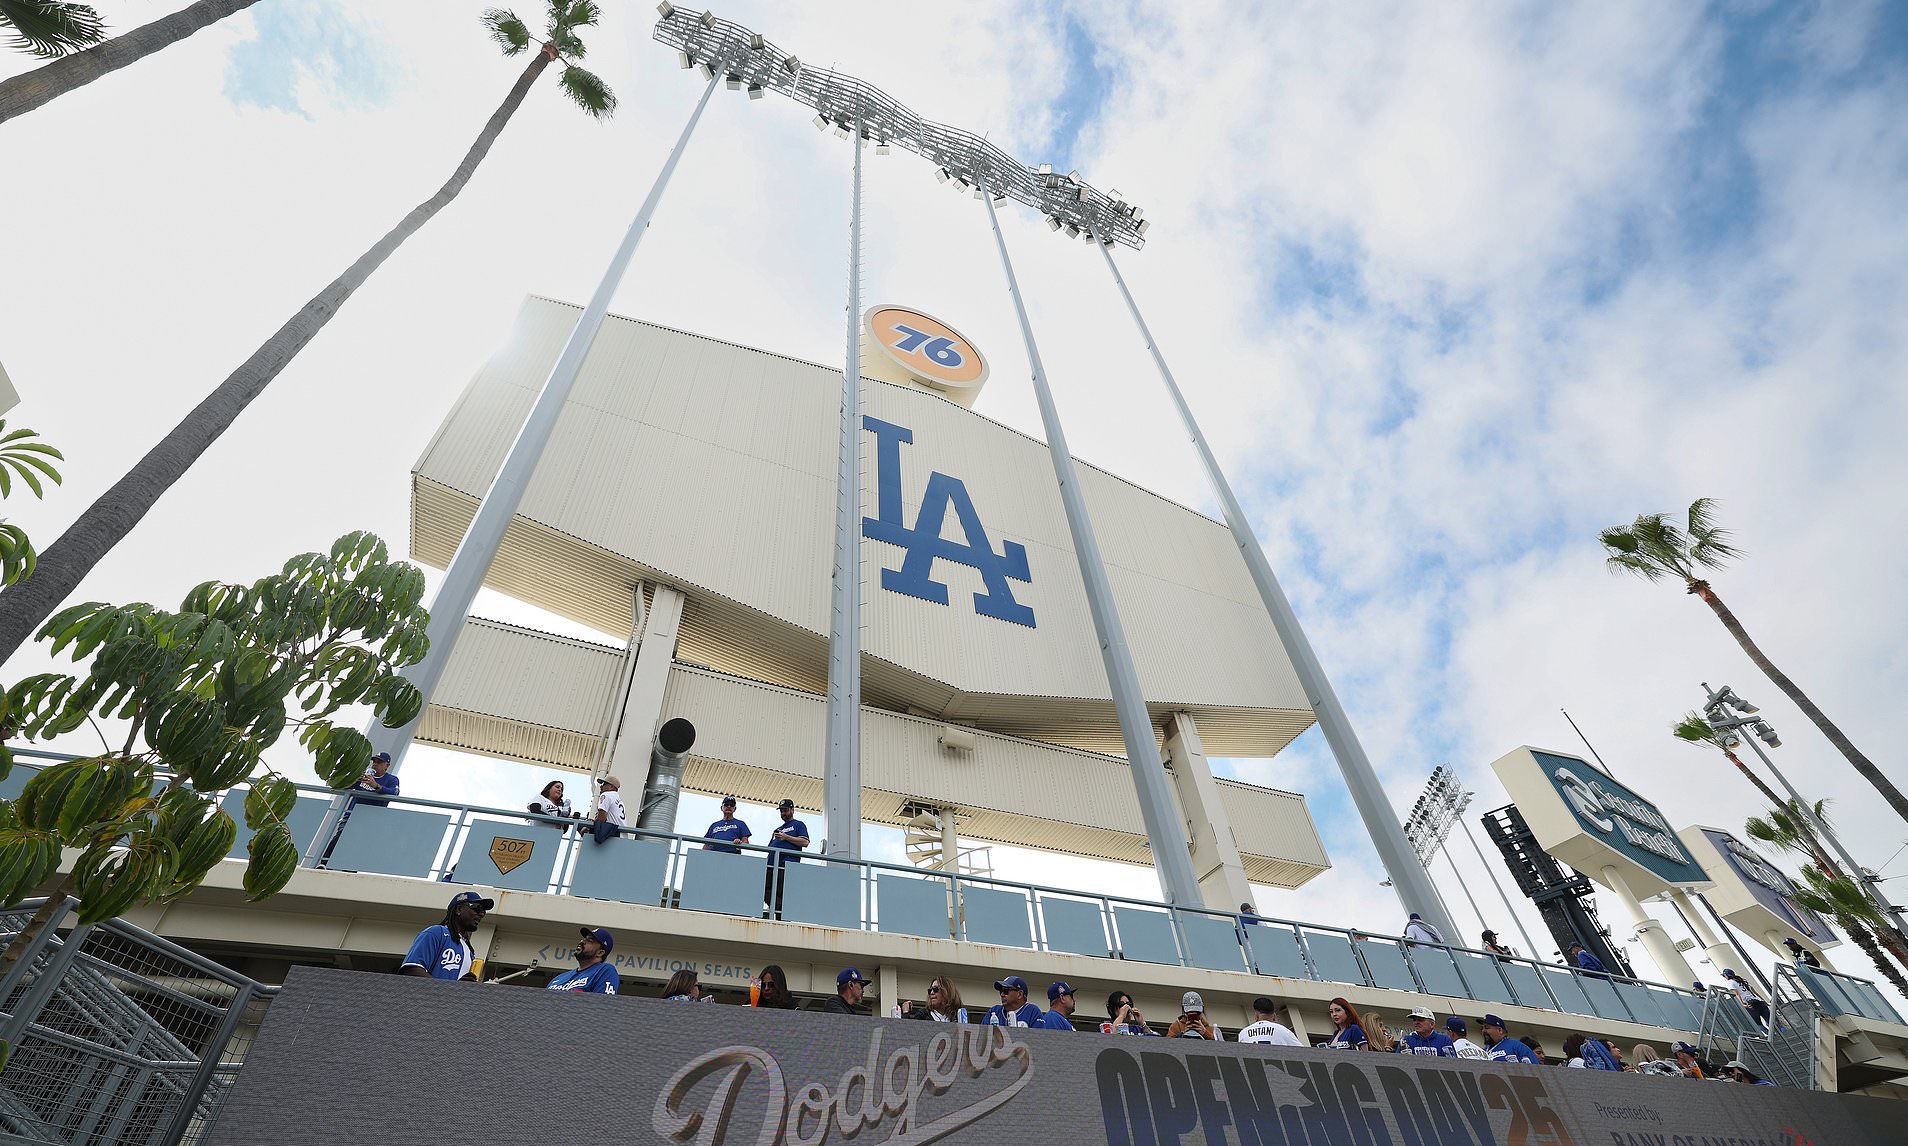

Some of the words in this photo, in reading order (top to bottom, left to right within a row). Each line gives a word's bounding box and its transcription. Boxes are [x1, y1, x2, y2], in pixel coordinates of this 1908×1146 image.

[891, 324, 964, 369] 76
[862, 415, 1036, 629] LA
[1588, 780, 1673, 839] Security
[498, 840, 527, 853] 507
[1610, 813, 1690, 865] Benefit
[615, 954, 697, 972] PAVILION
[704, 963, 751, 979] SEATS
[605, 981, 616, 995] LA
[1247, 1027, 1275, 1038] OHTANI
[652, 1026, 1034, 1146] Dodgers
[1594, 1101, 1647, 1121] Presented
[1642, 1104, 1664, 1126] by:
